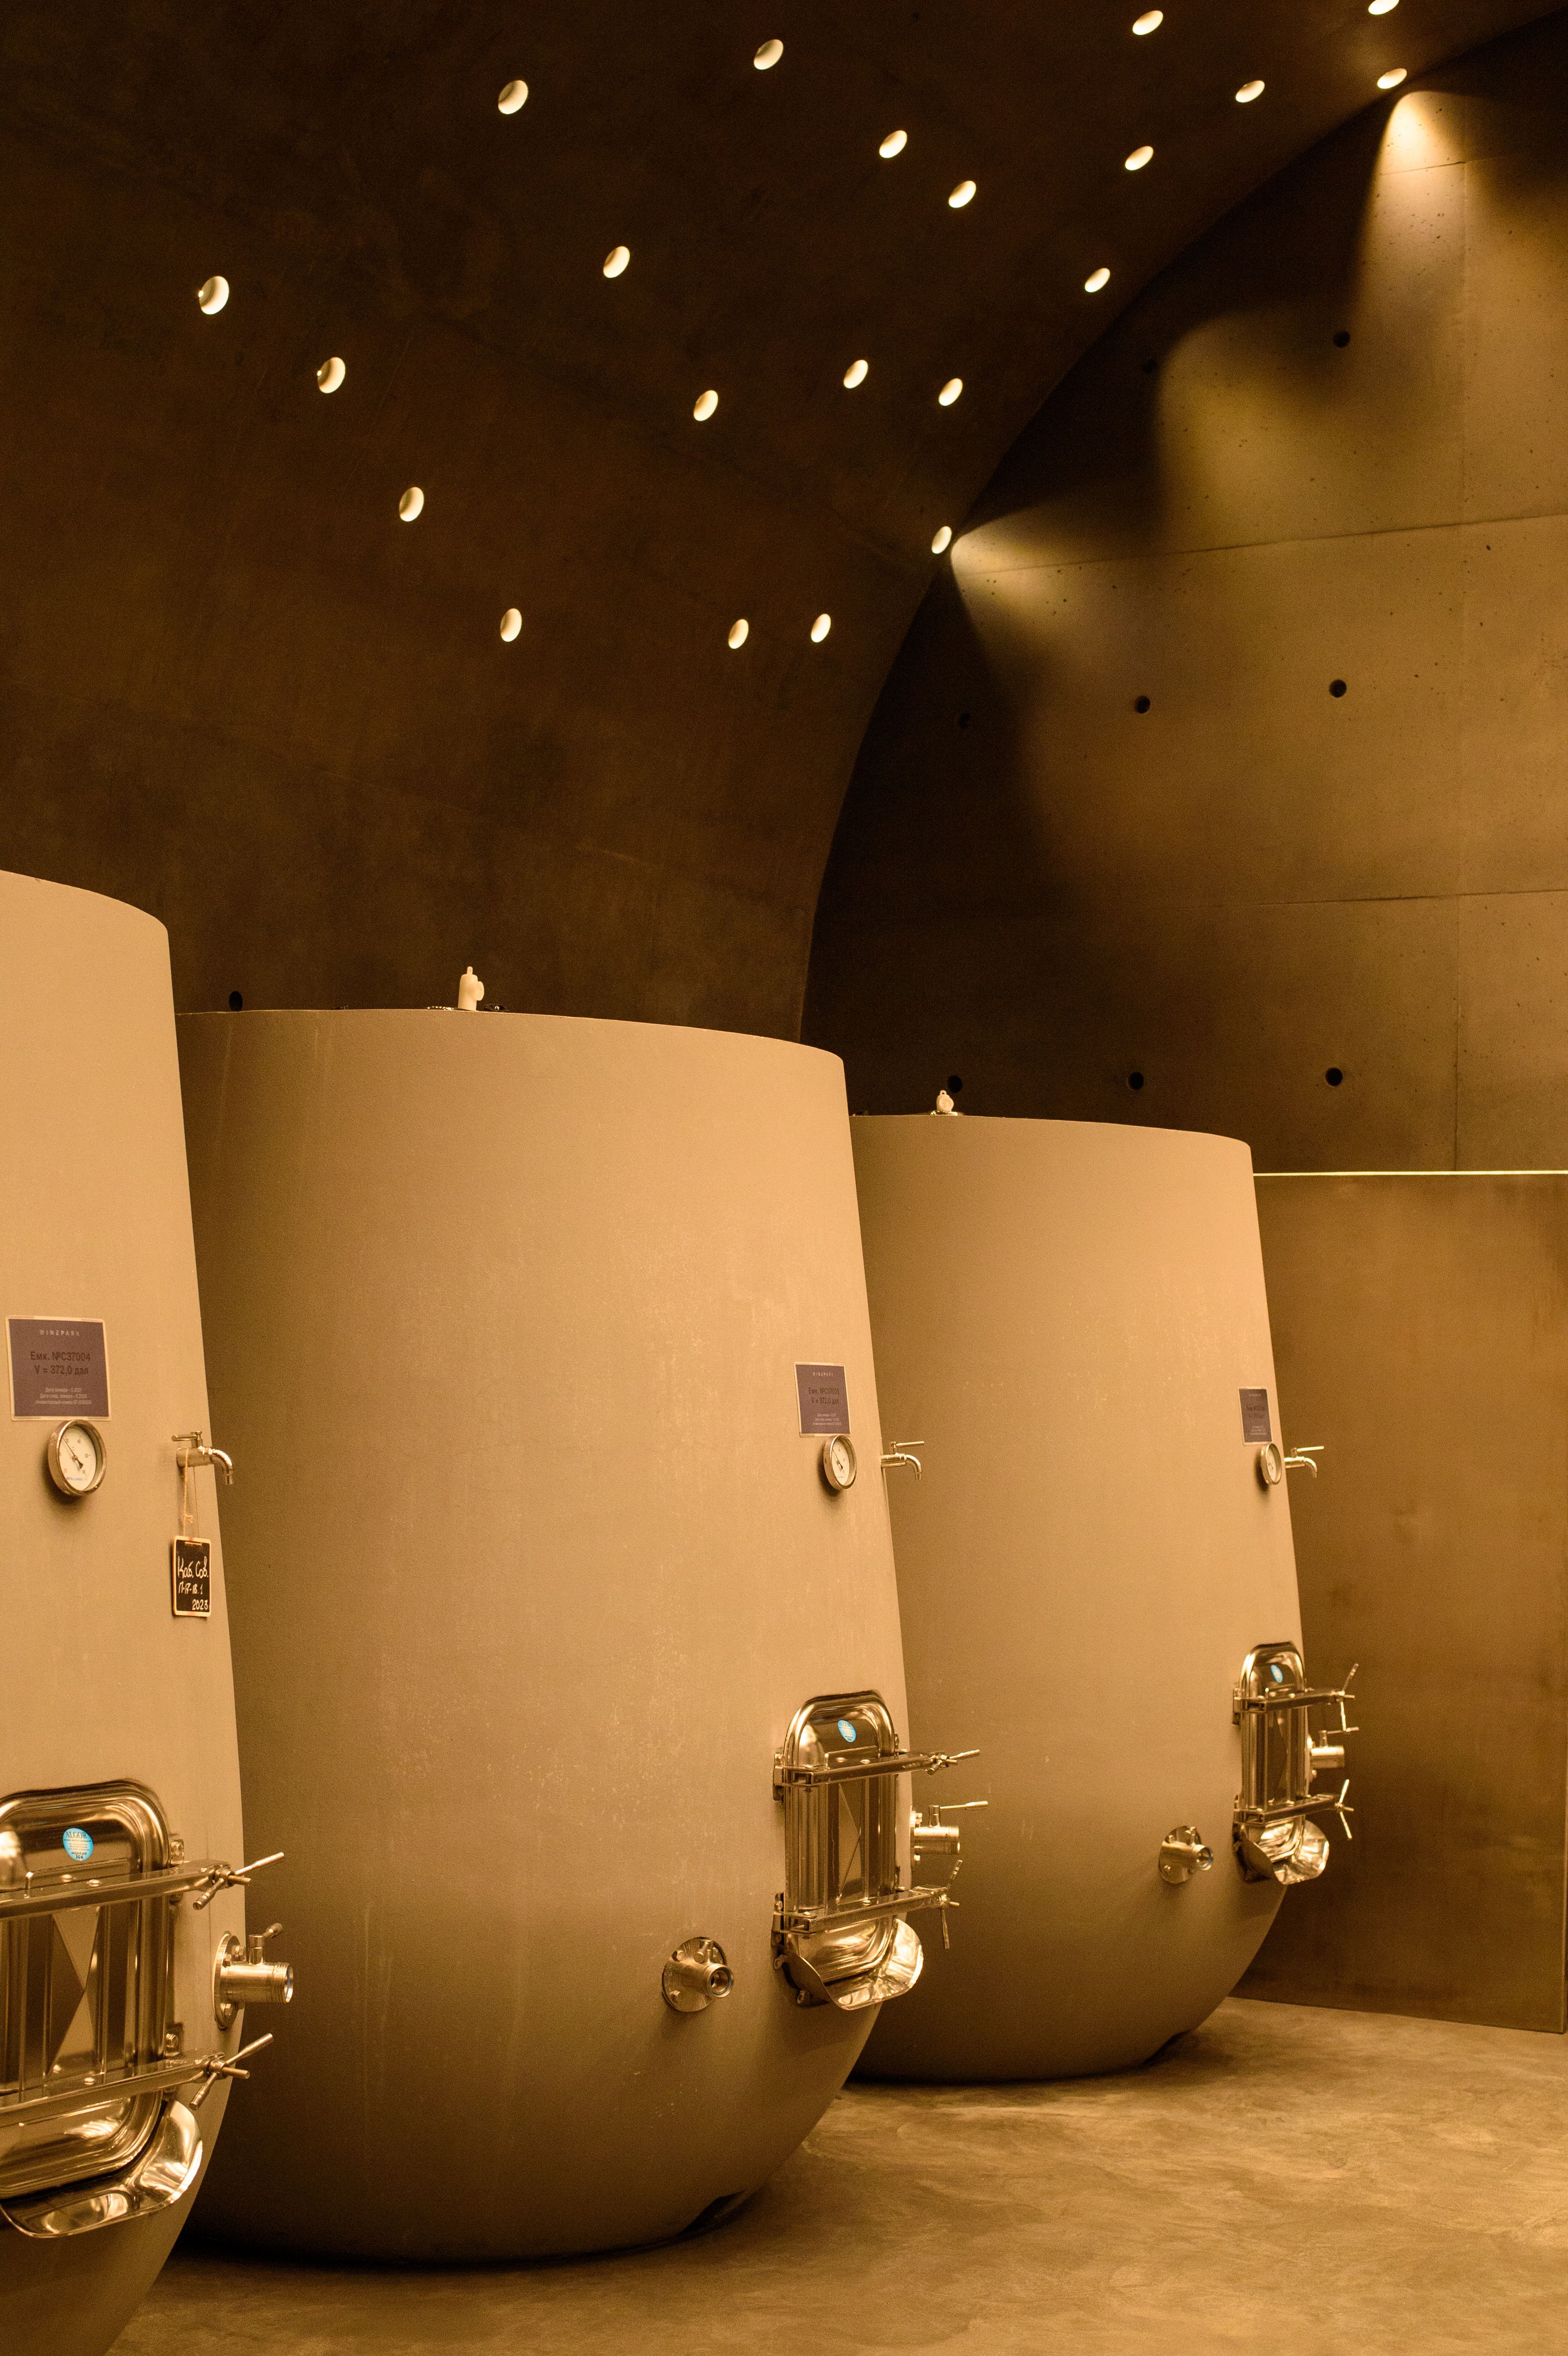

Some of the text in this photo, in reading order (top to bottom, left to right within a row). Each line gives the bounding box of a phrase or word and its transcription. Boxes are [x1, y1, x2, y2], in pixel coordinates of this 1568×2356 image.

[30, 1351, 50, 1360] Емк.
[34, 1365, 40, 1374] V
[50, 1365, 72, 1375] 372,0
[192, 1599, 208, 1611] 2023
[65, 1831, 87, 1839] ALGOR
